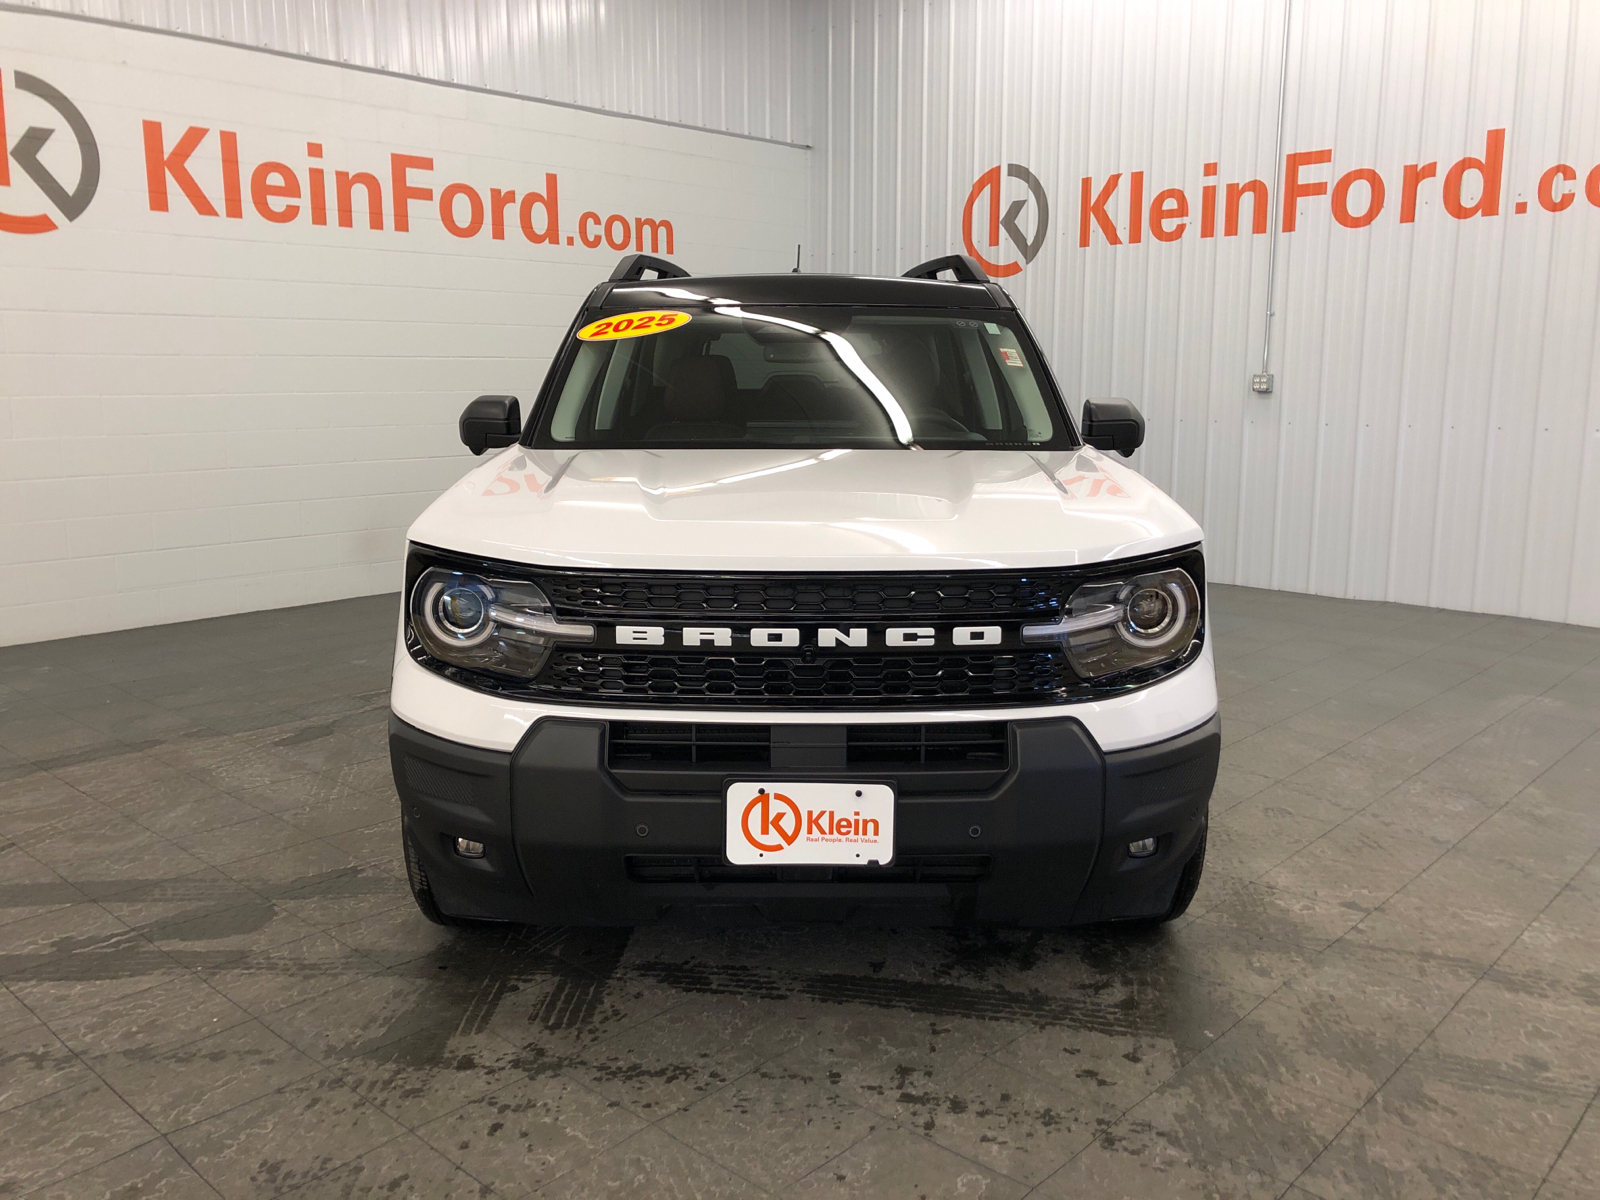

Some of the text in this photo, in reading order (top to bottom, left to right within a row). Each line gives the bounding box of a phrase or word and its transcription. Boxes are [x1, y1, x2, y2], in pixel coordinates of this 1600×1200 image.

[142, 119, 675, 255] KleinFord.com
[589, 314, 678, 338] 2025
[615, 625, 1002, 647] BRONCO
[806, 810, 880, 837] Klein
